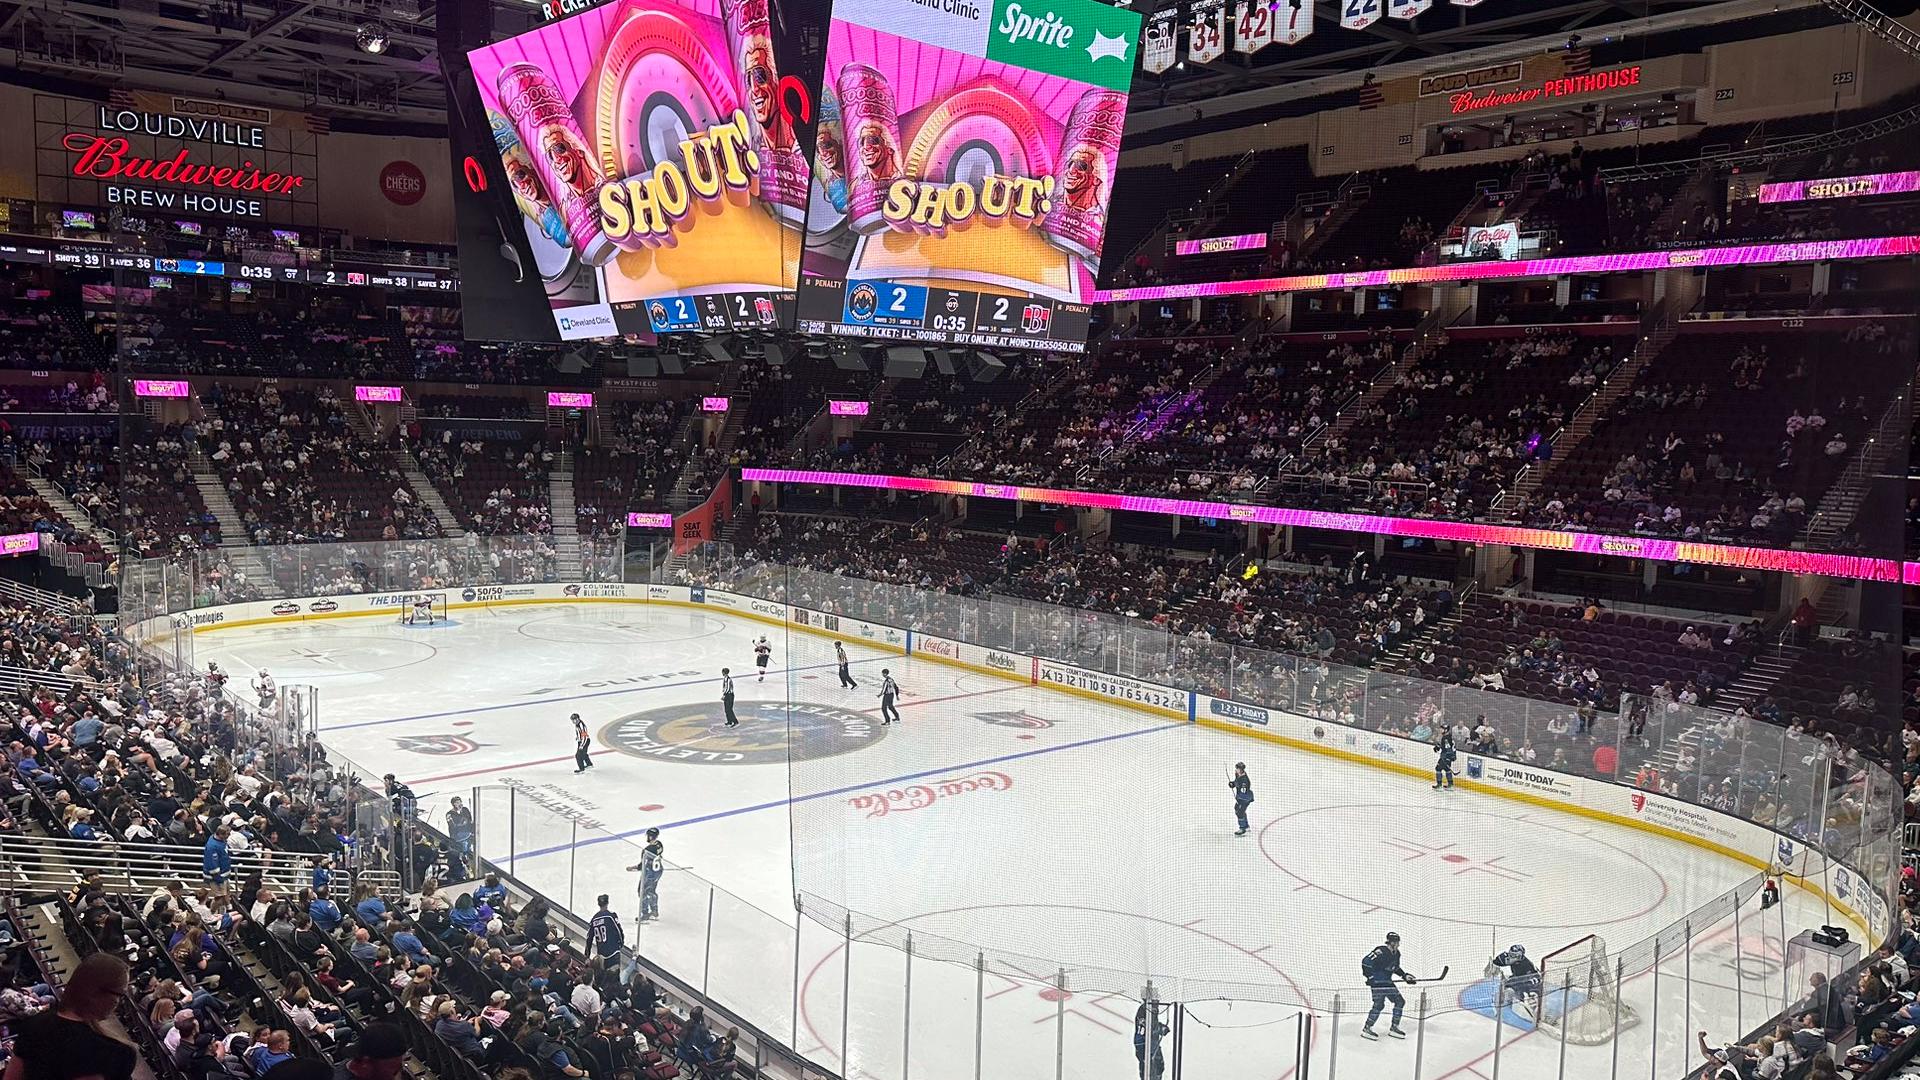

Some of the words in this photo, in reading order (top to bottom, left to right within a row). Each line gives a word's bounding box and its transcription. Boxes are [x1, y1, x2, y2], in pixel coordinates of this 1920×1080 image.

[999, 7, 1073, 48] Sprite
[1239, 8, 1268, 40] 42
[1834, 73, 1852, 83] 225
[1450, 87, 1541, 114] Budweiser
[1544, 66, 1641, 97] PENTHOUSE
[1717, 90, 1733, 99] 224
[101, 107, 263, 148] LOUDVILLE
[63, 133, 303, 194] Budweiser
[600, 109, 760, 240] SHOUT!
[386, 177, 420, 191] CHEERS
[1809, 180, 1872, 197] SHOUT!
[108, 187, 175, 208] BREW
[184, 194, 261, 217] HOUSE
[883, 175, 1055, 228] SHOUT!
[55, 254, 80, 263] SHOTS
[84, 254, 99, 265] 39
[137, 259, 151, 269] 36
[195, 261, 206, 274] 2
[241, 266, 272, 278] 0:35
[326, 272, 335, 283] 2
[372, 277, 393, 285] SHOTS
[395, 278, 407, 287] 38
[417, 280, 437, 288] SAVES
[440, 280, 452, 289] 37
[815, 279, 842, 289] PENALTY
[735, 296, 749, 317] 2
[890, 287, 907, 312] 2
[675, 299, 689, 319] 2
[993, 298, 1009, 321] 2
[1066, 305, 1089, 314] PENALTY
[571, 318, 596, 328] Cleveland
[596, 316, 611, 325] Clinic
[706, 315, 726, 328] 0:35
[934, 314, 966, 332] 0:35
[831, 323, 867, 337] WINNING
[869, 327, 899, 338] TICKET:
[954, 332, 969, 343] BUY
[971, 333, 998, 346] ONLINE
[999, 336, 1008, 346] AT
[1010, 338, 1085, 353] MONSTERS5050.COM
[682, 530, 701, 538] GEEK
[684, 522, 701, 531] SEAT
[477, 587, 503, 596] 50/50
[584, 589, 598, 597] BLUE
[751, 601, 769, 613] Great
[770, 604, 785, 618] Clips
[582, 670, 702, 688] CLIFFS
[1066, 668, 1098, 680] COUNTDOWN
[1110, 677, 1130, 687] CALDER
[1054, 671, 1063, 683] 13
[1066, 674, 1075, 686] 12
[1079, 677, 1086, 689] 11
[1090, 680, 1098, 691] 10
[1101, 683, 1107, 693] 9
[1110, 685, 1116, 695] 8
[1119, 686, 1124, 697] 7
[1127, 689, 1133, 699] 6
[1135, 690, 1142, 701] 5
[1144, 692, 1151, 703] 4
[1153, 694, 1159, 705] 3
[1163, 696, 1169, 708] 2
[1238, 707, 1266, 720] FRIDAYS
[1504, 767, 1523, 780] JOIN
[1524, 772, 1555, 786] TODAY
[848, 771, 1013, 819] Coca-Cola
[1541, 786, 1559, 794] SEASON
[1646, 799, 1678, 814] University
[1679, 808, 1708, 822] Hospitals
[652, 857, 660, 871] 6
